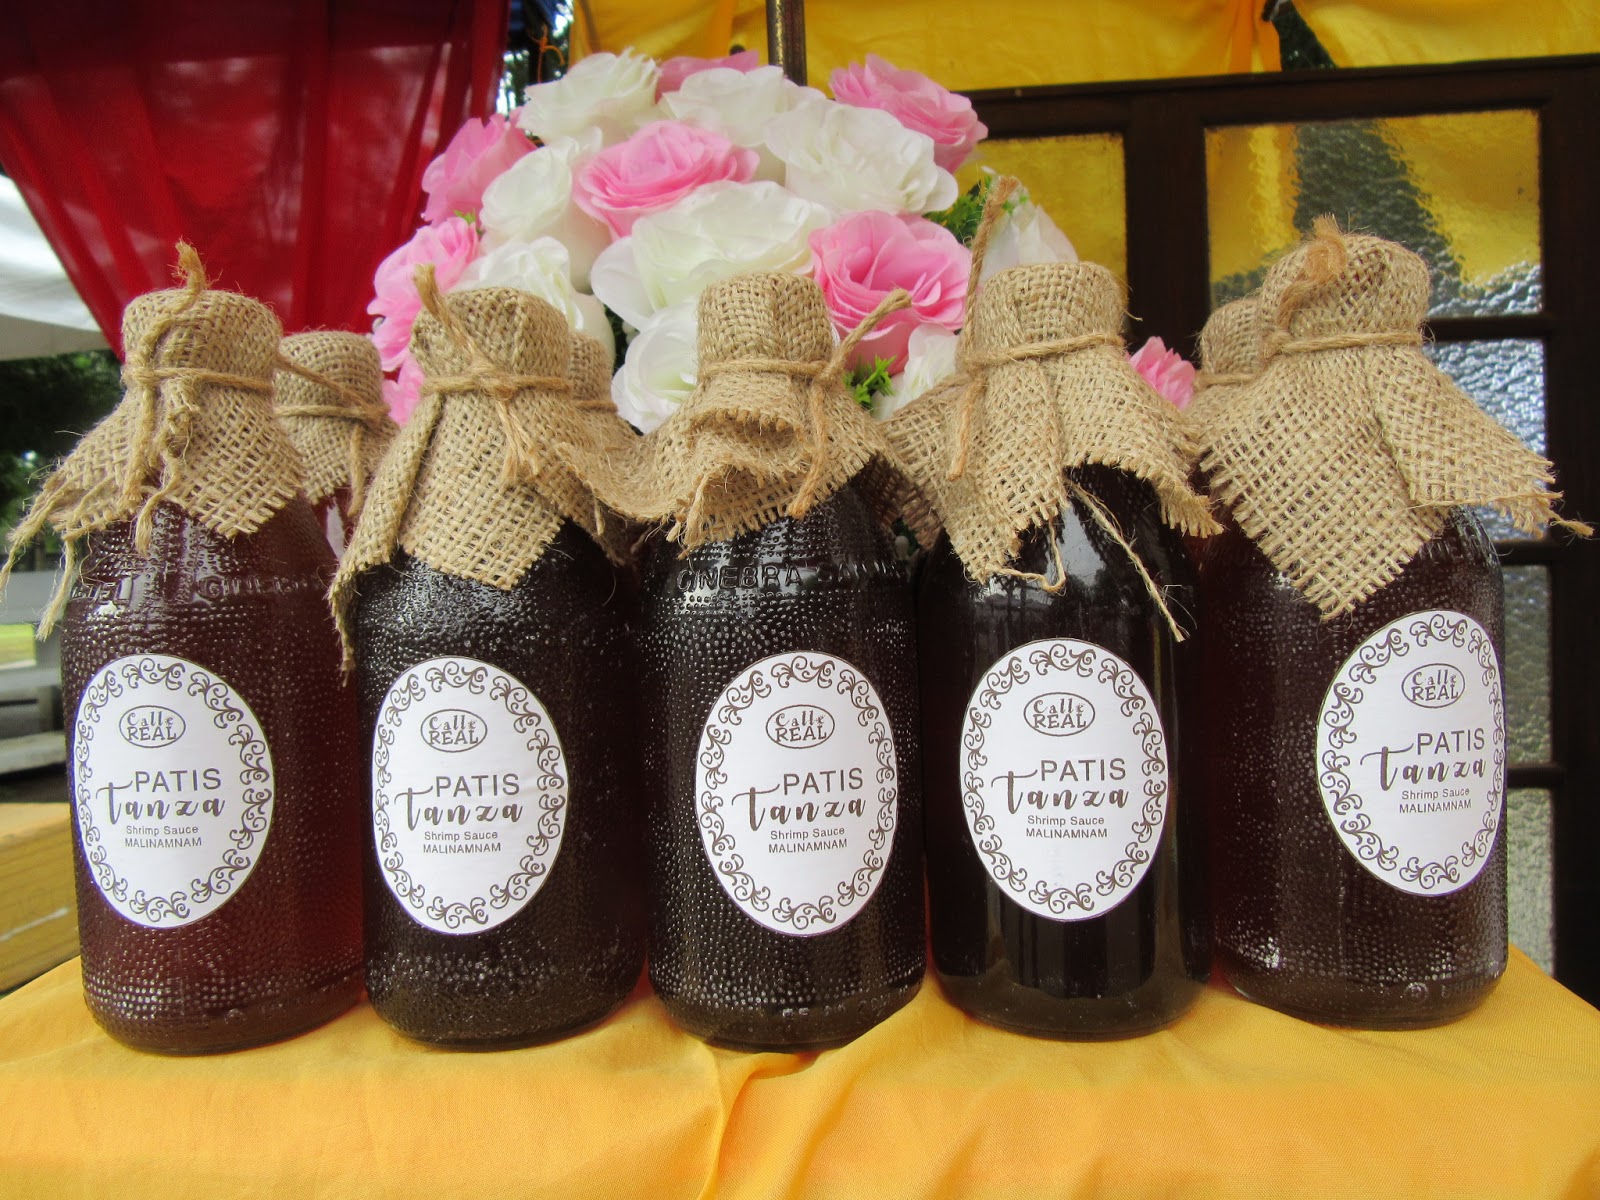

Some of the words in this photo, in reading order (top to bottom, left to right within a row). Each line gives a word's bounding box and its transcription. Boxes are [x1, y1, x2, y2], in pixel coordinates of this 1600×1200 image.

[1411, 685, 1459, 701] REAL
[1033, 714, 1087, 729] REAL
[127, 726, 176, 741] REAL
[429, 730, 479, 745] REAL
[775, 726, 827, 742] REAL
[1417, 728, 1485, 755] PATIS
[1041, 758, 1127, 782] PATIS
[135, 768, 222, 793] PATIS
[436, 773, 520, 797] PATIS
[783, 768, 864, 796] PATIS
[1401, 790, 1439, 800] Shrimp
[1442, 787, 1470, 797] Sauce
[1399, 799, 1472, 813] MALINAMNAM
[1027, 815, 1066, 826] Shrimp
[1070, 816, 1105, 825] Sauce
[126, 825, 160, 835] Shrimp
[163, 826, 199, 835] Sauce
[424, 831, 460, 842] Shrimp
[464, 831, 498, 840] Sauce
[770, 830, 809, 841] Shrimp
[812, 827, 845, 838] Sauce
[1026, 828, 1108, 838] MALINAMNAM
[125, 837, 202, 848] MALINAMNAM
[423, 842, 501, 854] MALINAMNAM
[768, 839, 847, 853] MALINAMNAM
